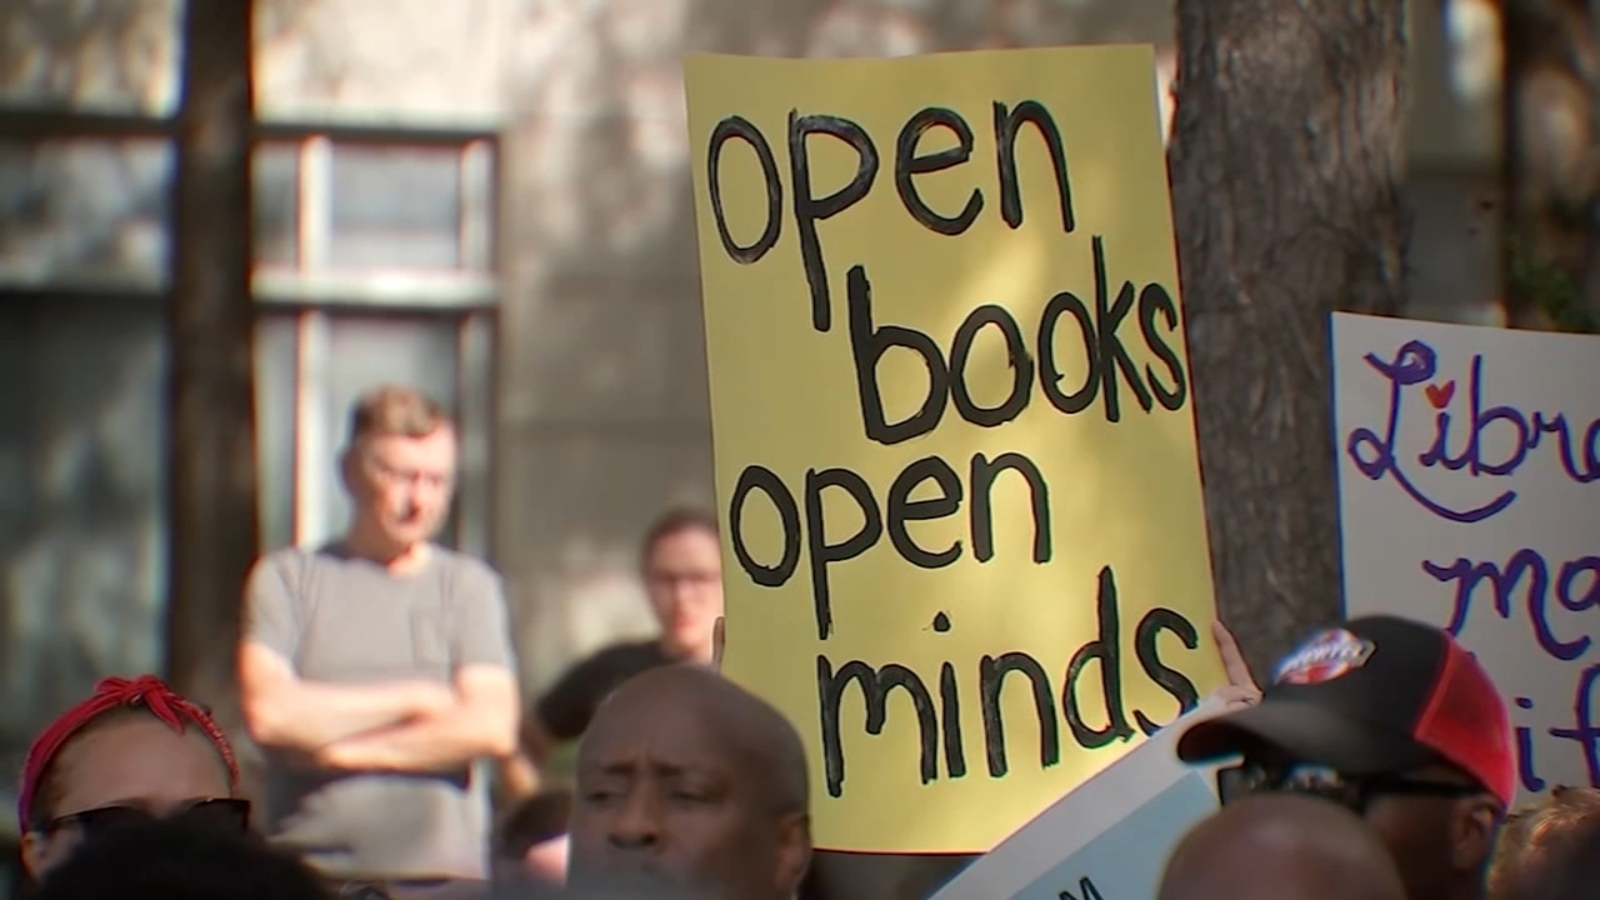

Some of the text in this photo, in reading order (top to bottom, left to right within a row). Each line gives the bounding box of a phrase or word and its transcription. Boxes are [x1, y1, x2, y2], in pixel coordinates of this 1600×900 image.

[708, 100, 1075, 332] open
[847, 235, 1186, 444] books
[729, 452, 1051, 640] open
[817, 565, 1198, 798] minds
